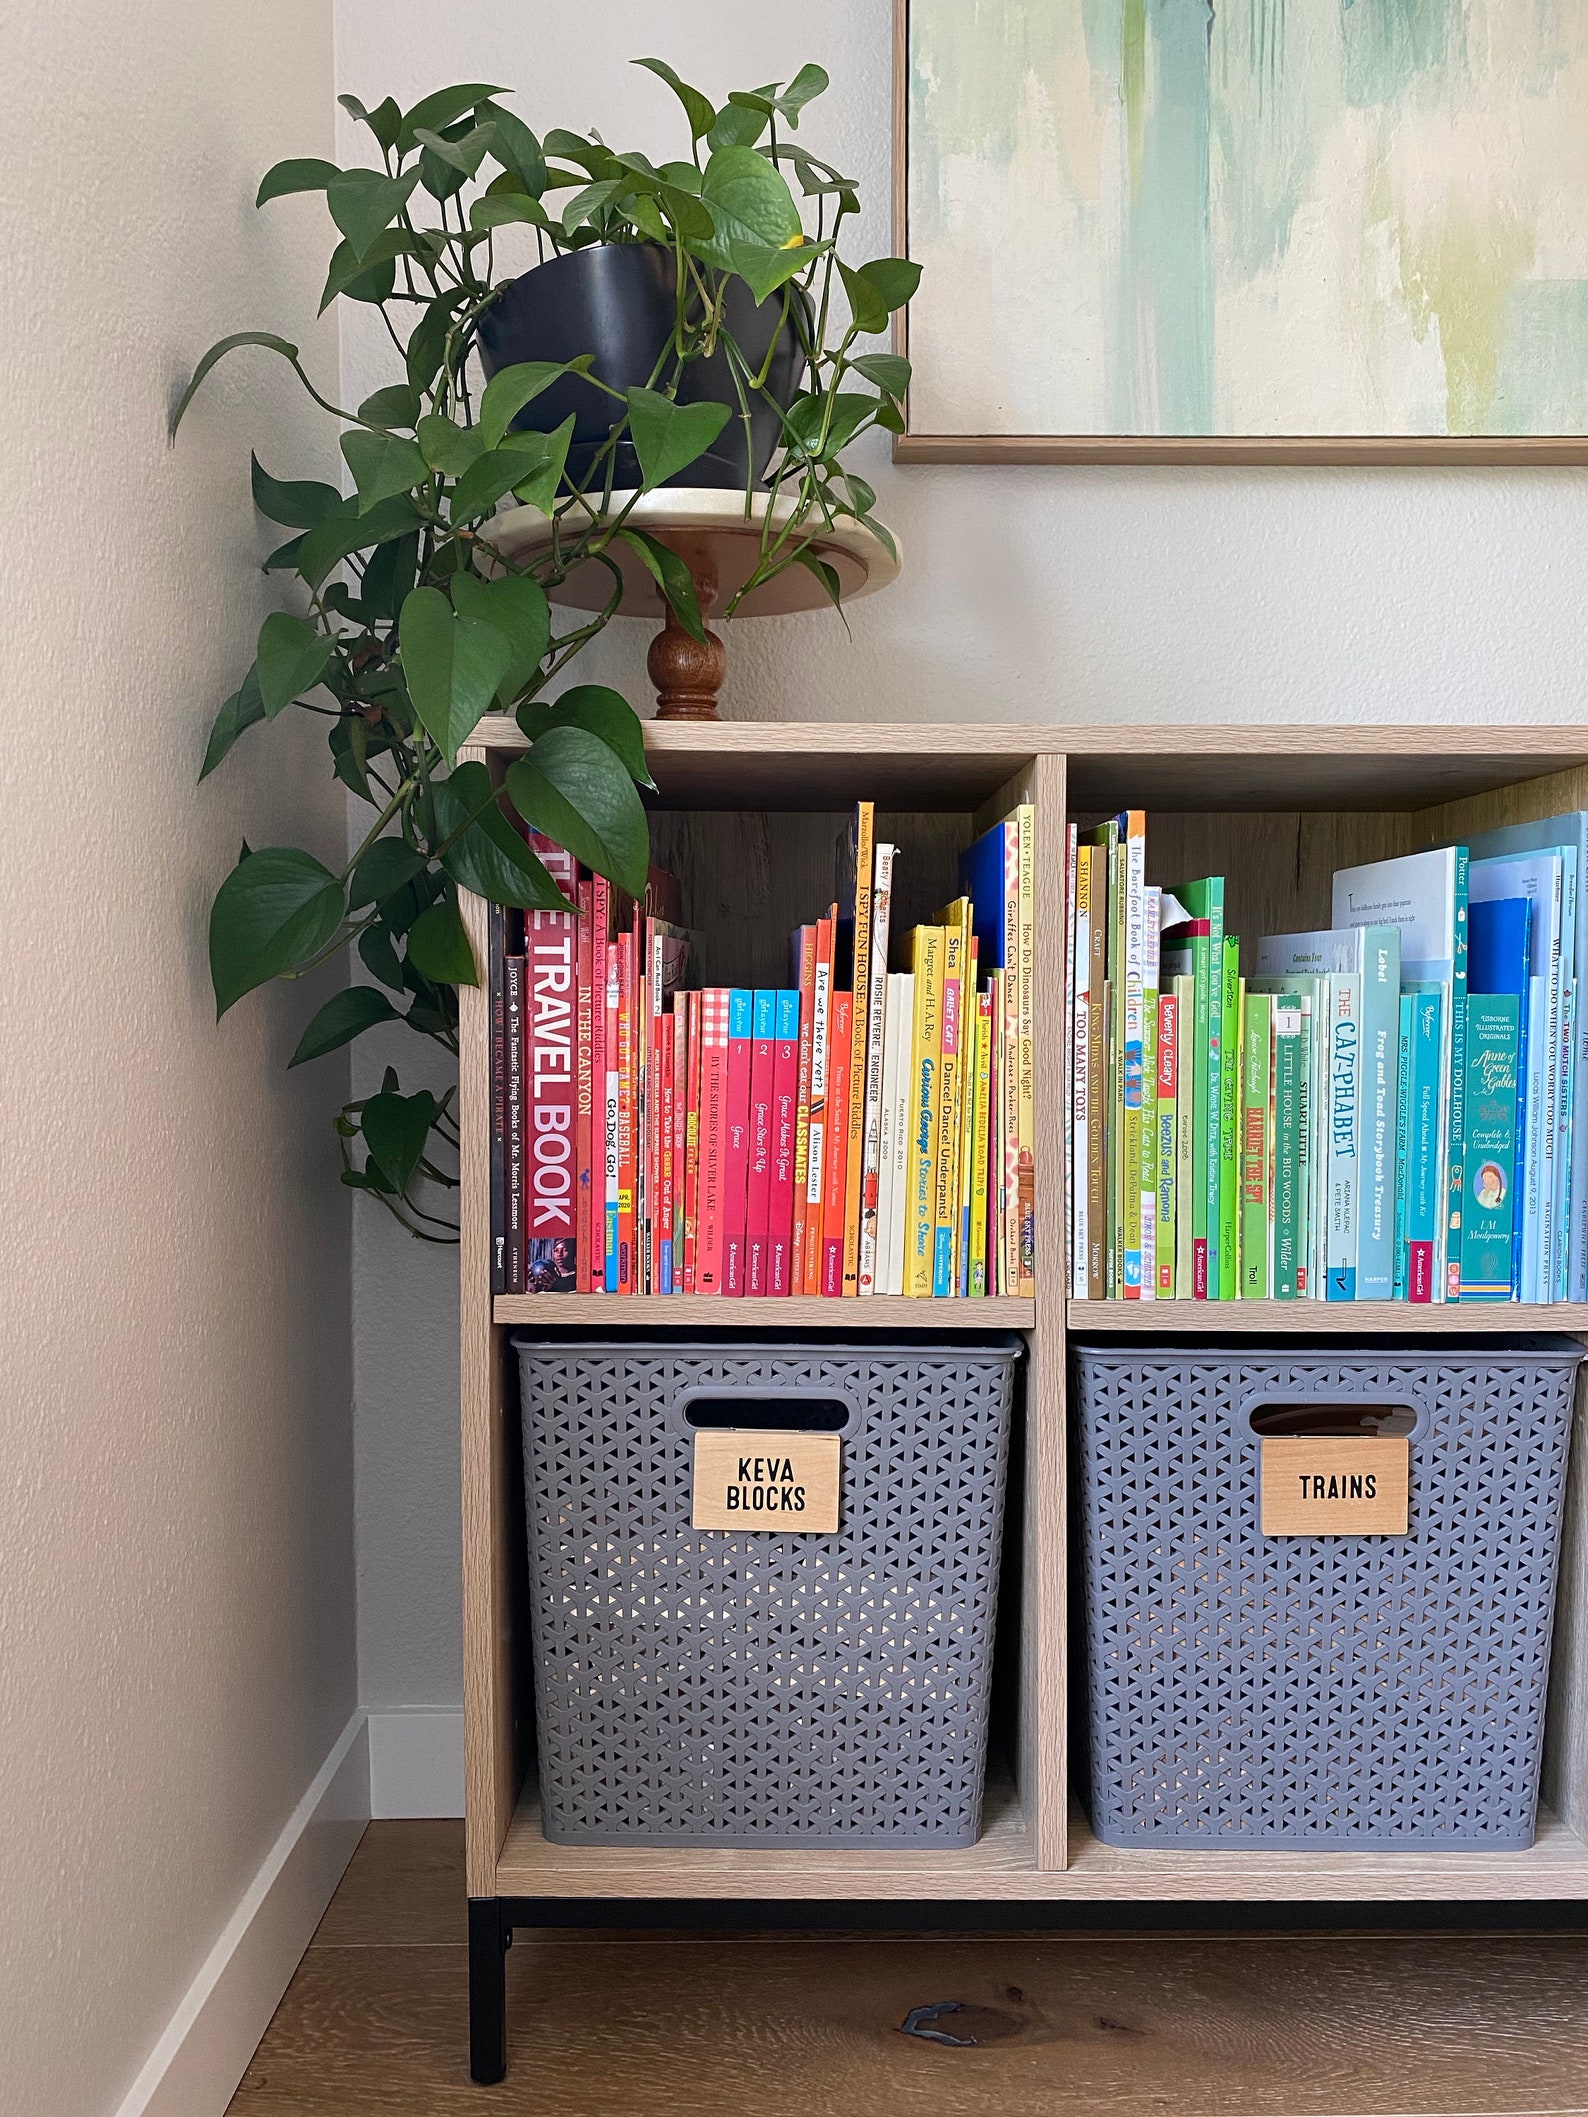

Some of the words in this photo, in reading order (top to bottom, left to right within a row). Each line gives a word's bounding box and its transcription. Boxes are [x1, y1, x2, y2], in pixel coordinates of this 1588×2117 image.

[860, 812, 869, 868] Marzollo/Wick
[1023, 815, 1031, 849] YOLEN
[1131, 845, 1141, 858] The
[1022, 857, 1030, 899] TEAGUE
[1457, 856, 1467, 885] Potter
[1079, 861, 1088, 918] SHANNON
[1130, 870, 1141, 918] Barefoot
[858, 893, 869, 918] SPY
[1007, 901, 1016, 941] Giraffes
[1022, 924, 1032, 945] How
[857, 922, 868, 949] FUN
[1131, 924, 1140, 949] Book
[804, 943, 813, 986] HIGGINS
[924, 938, 937, 977] Margret
[948, 938, 959, 968] Shea
[1007, 946, 1016, 971] Can't
[1022, 950, 1031, 963] Do
[1130, 954, 1141, 965] of
[1377, 949, 1388, 982] Lobel
[509, 967, 517, 996] JOYCE
[856, 953, 867, 1003] HOUSE:
[926, 979, 934, 996] and
[1007, 974, 1016, 1004] Dance
[1022, 967, 1031, 1015] Dinosaurs
[1226, 969, 1236, 1008] Silverstein
[1551, 971, 1558, 985] TO
[579, 986, 591, 1003] IN
[926, 998, 935, 1010] H.
[1127, 971, 1140, 1030] Children
[1338, 989, 1351, 1017] THE
[1550, 988, 1558, 1004] DO
[511, 1017, 519, 1033] The
[533, 937, 571, 1098] TRAVEL
[579, 1009, 591, 1041] THE
[855, 1006, 864, 1018] A
[925, 1012, 934, 1022] A.
[1077, 1011, 1086, 1039] TOO
[1454, 1002, 1464, 1029] THIS
[1549, 1007, 1557, 1038] WHEN
[801, 1023, 810, 1038] we
[854, 1019, 864, 1046] Book
[921, 1024, 934, 1042] Rey
[1020, 1019, 1030, 1036] Say
[1454, 1033, 1463, 1044] IS
[511, 1037, 519, 1072] Fantastic
[759, 1045, 767, 1055] 2
[800, 1040, 810, 1066] don't
[854, 1049, 863, 1062] of
[1022, 1039, 1031, 1065] Good
[1376, 1031, 1386, 1058] Frog
[1400, 1036, 1408, 1054] MRS.
[1454, 1047, 1462, 1065] MY
[710, 1056, 719, 1068] BY
[800, 1067, 809, 1082] eat
[1076, 1044, 1086, 1083] MANY
[1283, 1045, 1292, 1086] LITTLE
[1376, 1062, 1385, 1084] and
[510, 1076, 520, 1101] Flying
[578, 1046, 591, 1115] CANYON
[710, 1072, 719, 1091] THE
[799, 1085, 809, 1102] our
[852, 1064, 863, 1099] Picture
[921, 1059, 934, 1107] Curious
[943, 1063, 953, 1102] Dance!
[1021, 1068, 1031, 1099] Night?
[1333, 1022, 1356, 1159] CAT-PHABET
[1398, 1056, 1407, 1127] PIGGLE-WIGGLE'S
[1547, 1064, 1555, 1100] WORRY
[709, 1094, 718, 1131] SHORES
[755, 1104, 767, 1126] Grace
[778, 1096, 791, 1118] Grace
[1076, 1088, 1085, 1121] TOYS
[1283, 1090, 1292, 1128] HOUSE
[1299, 1081, 1307, 1125] STUART
[1376, 1088, 1385, 1117] Toad
[1452, 1069, 1462, 1141] DOLLHOUSE
[511, 1105, 519, 1129] Books
[850, 1102, 861, 1139] Riddles
[941, 1106, 952, 1145] Dance!
[511, 1133, 520, 1141] of
[708, 1134, 717, 1146] OF
[731, 1126, 743, 1148] Grace
[756, 1128, 767, 1145] Stirs
[779, 1120, 790, 1147] Makes
[795, 1106, 808, 1184] CLASSMATES
[917, 1110, 933, 1154] George
[1128, 1116, 1138, 1166] Strickland,
[1246, 1107, 1264, 1156] HARRIET
[1283, 1133, 1291, 1141] in
[1530, 1125, 1539, 1157] Johnson
[1545, 1129, 1554, 1159] MUCH
[511, 1145, 519, 1159] Mr.
[755, 1147, 766, 1157] It
[778, 1148, 789, 1157] It
[812, 1130, 821, 1162] Alison
[1283, 1143, 1291, 1154] the
[1299, 1129, 1307, 1167] LITTLE
[1373, 1121, 1385, 1182] Storybook
[512, 1163, 520, 1189] Morris
[533, 1104, 571, 1228] BOOK
[707, 1149, 717, 1183] SILVER
[753, 1159, 766, 1172] Up
[777, 1159, 789, 1181] Great
[918, 1158, 931, 1201] Stories
[1246, 1160, 1263, 1181] THE
[1282, 1158, 1292, 1177] BIG
[1397, 1158, 1405, 1200] MacDonald
[1529, 1159, 1538, 1186] August
[811, 1166, 820, 1198] Lester
[937, 1149, 950, 1219] Underpants!
[1129, 1170, 1137, 1208] DePalma
[1246, 1184, 1263, 1205] SPY
[512, 1193, 520, 1229] Lessmore
[706, 1185, 716, 1211] LAKE
[918, 1205, 929, 1216] to
[1282, 1180, 1291, 1224] WOODS
[1371, 1185, 1383, 1240] Treasury
[606, 1210, 616, 1256] Eastman
[917, 1222, 930, 1256] Share
[1129, 1221, 1137, 1244] Dean
[1224, 1221, 1232, 1269] HarperCollins
[1280, 1238, 1291, 1270] Wilder
[1249, 1266, 1258, 1285] Troll
[738, 1458, 794, 1482] KEVA
[726, 1486, 806, 1512] BLOCKS
[1299, 1475, 1377, 1500] TRAINS
